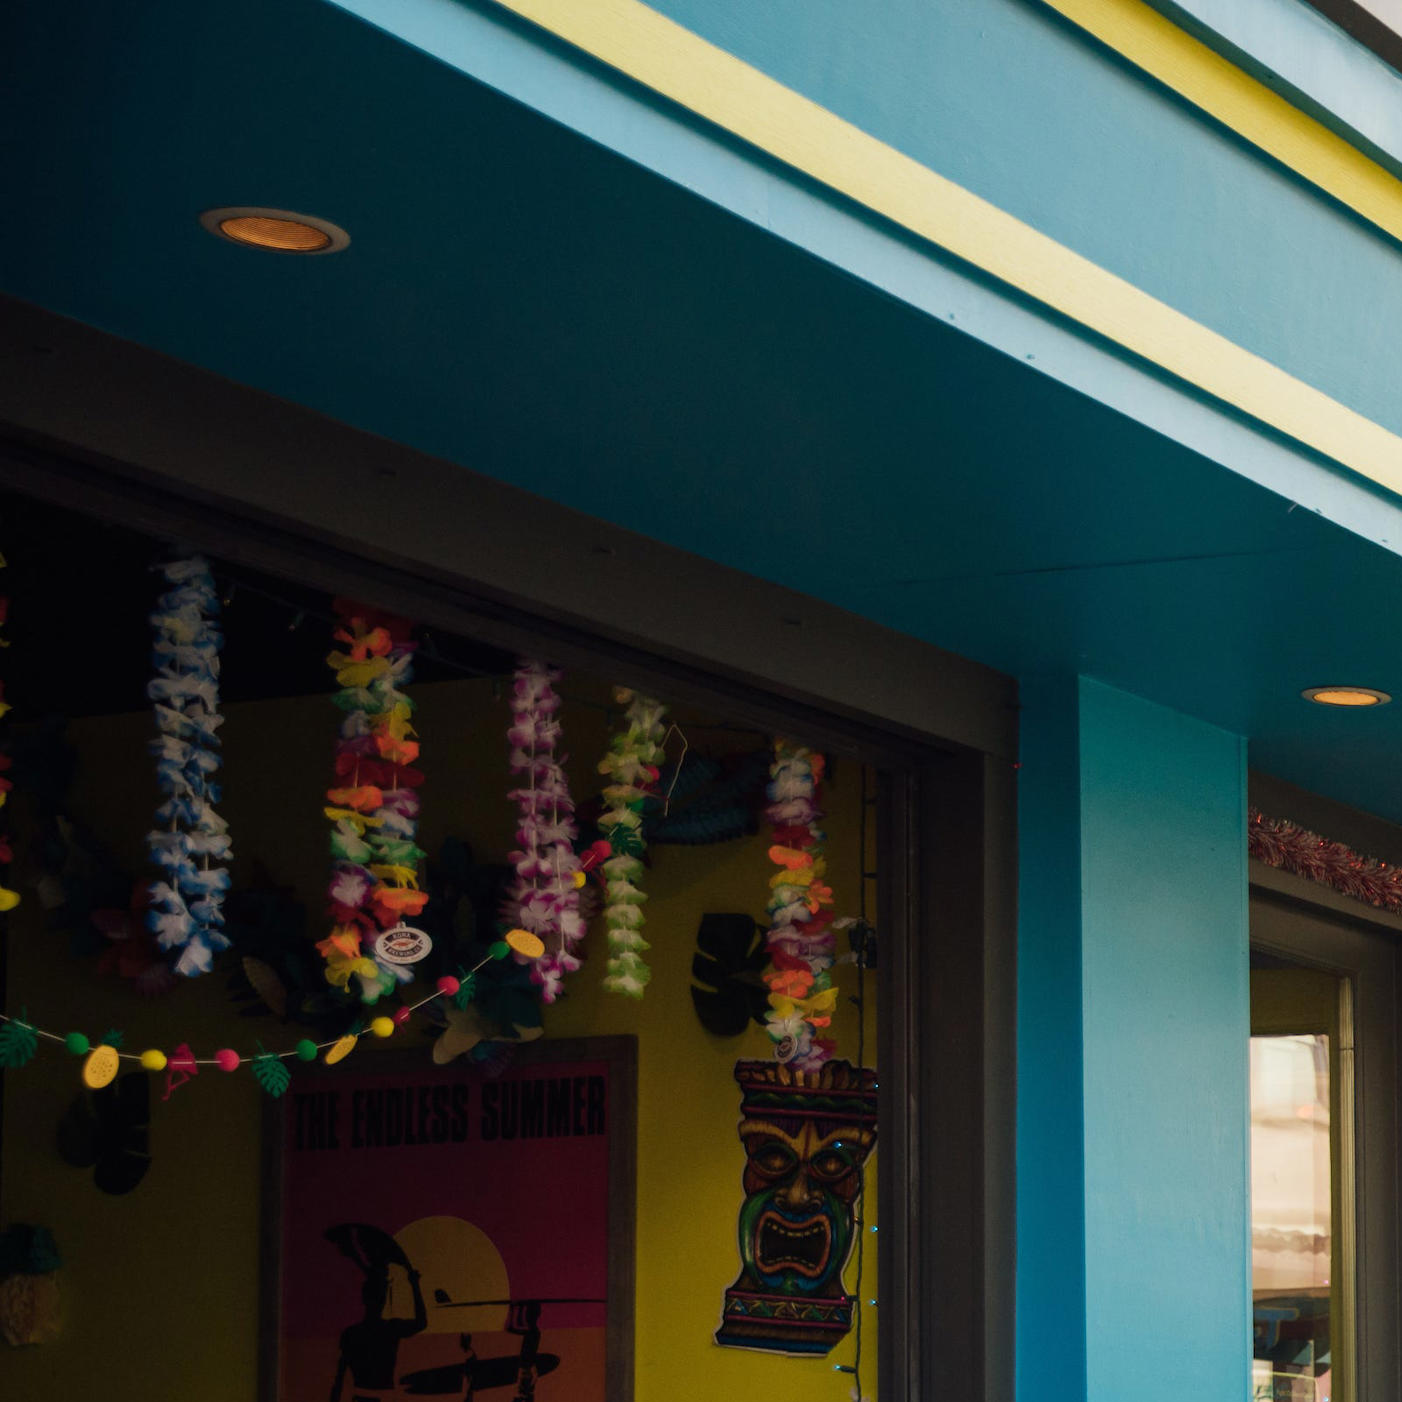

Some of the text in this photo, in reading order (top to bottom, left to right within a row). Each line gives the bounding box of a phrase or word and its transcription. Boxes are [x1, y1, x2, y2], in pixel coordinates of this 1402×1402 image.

[294, 1076, 605, 1150] THE ENDLESS SUMMER
